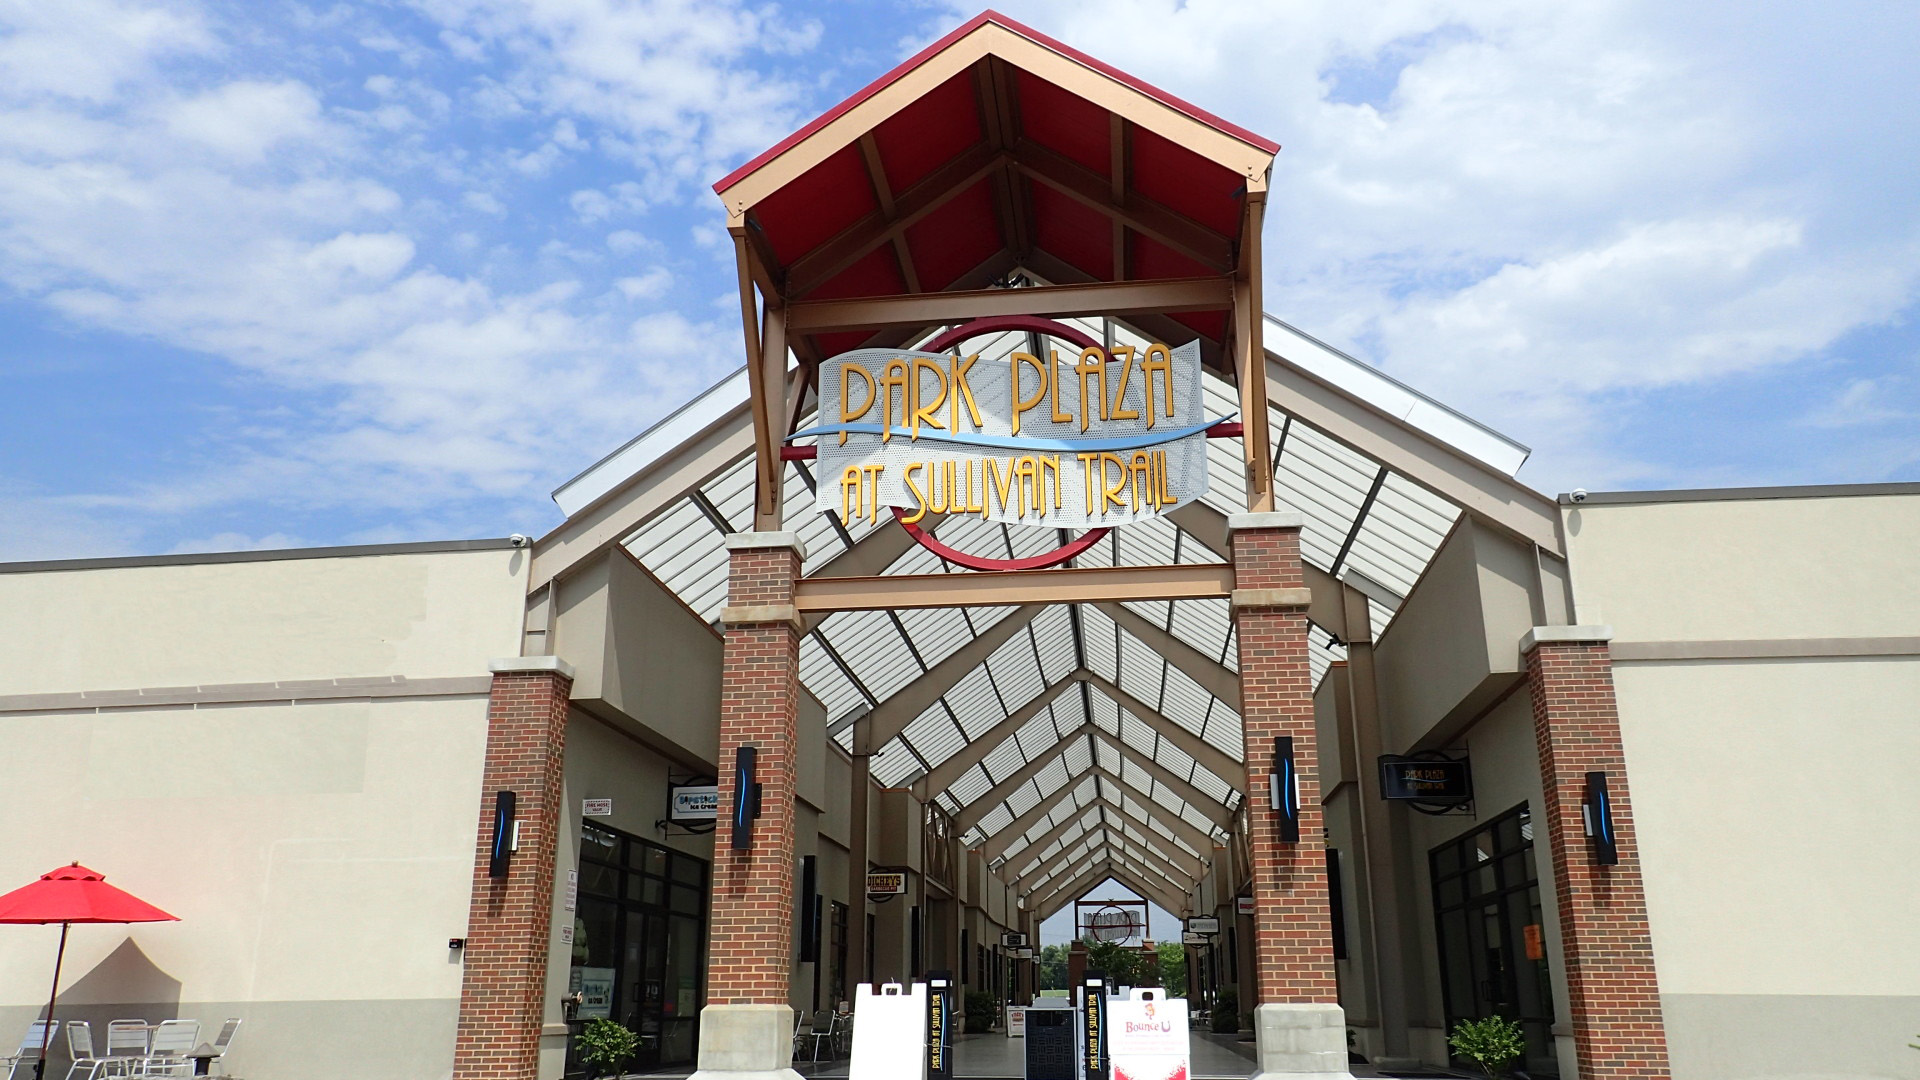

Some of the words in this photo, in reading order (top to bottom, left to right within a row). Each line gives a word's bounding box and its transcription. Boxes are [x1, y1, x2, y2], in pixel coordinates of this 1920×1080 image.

[838, 353, 984, 447] PARK
[1010, 343, 1176, 436] PLAZA
[840, 464, 885, 527] AT
[901, 454, 1062, 525] SULLIVAN
[1077, 450, 1179, 517] TRAIL
[932, 1007, 941, 1029] SULLIVAN
[1088, 1007, 1098, 1029] SULLIVAN
[932, 1037, 941, 1054] PLAZA
[1089, 1038, 1098, 1054] PLAZA
[932, 1054, 941, 1069] PARK
